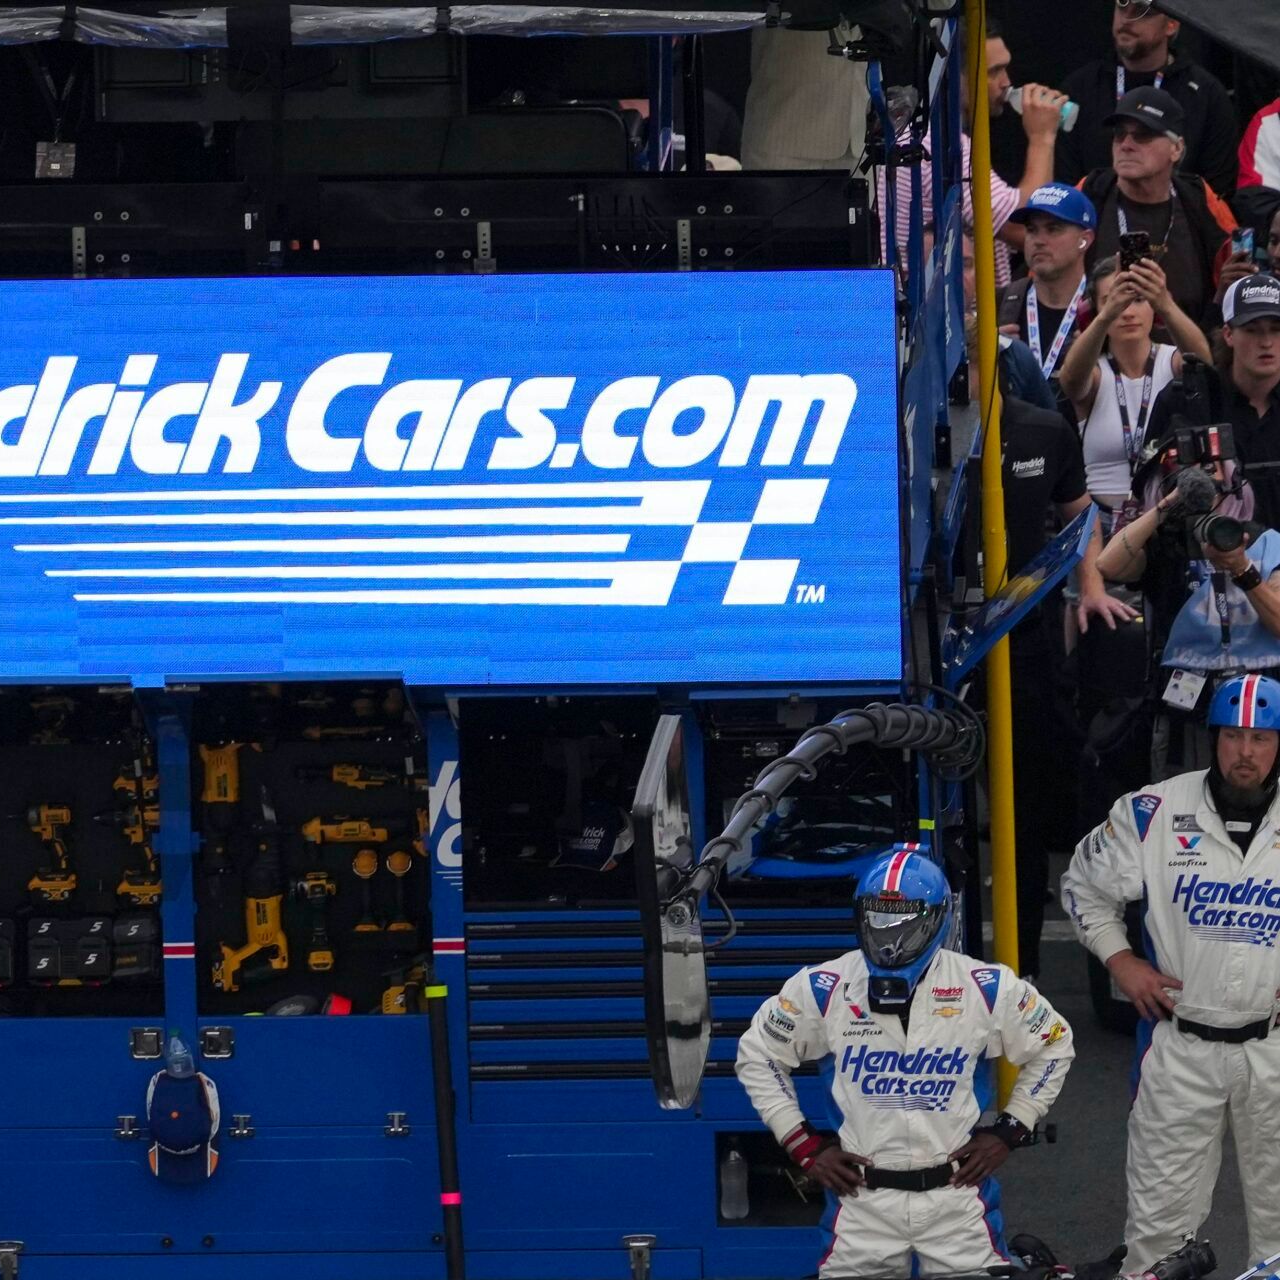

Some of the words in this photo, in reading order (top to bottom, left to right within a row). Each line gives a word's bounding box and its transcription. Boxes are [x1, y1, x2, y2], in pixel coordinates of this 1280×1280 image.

[1012, 456, 1045, 473] Hendrick
[797, 584, 826, 604] TM
[1168, 858, 1207, 868] GOODYEAR
[37, 922, 52, 934] 5
[89, 921, 104, 933] 5
[126, 924, 140, 937] 5
[36, 957, 50, 970] 5
[84, 953, 98, 966] 5
[931, 985, 965, 998] Hendrick
[842, 1028, 883, 1039] GOODYEAR
[840, 1044, 970, 1083] Hendrick
[860, 1074, 958, 1097] Cars.com
